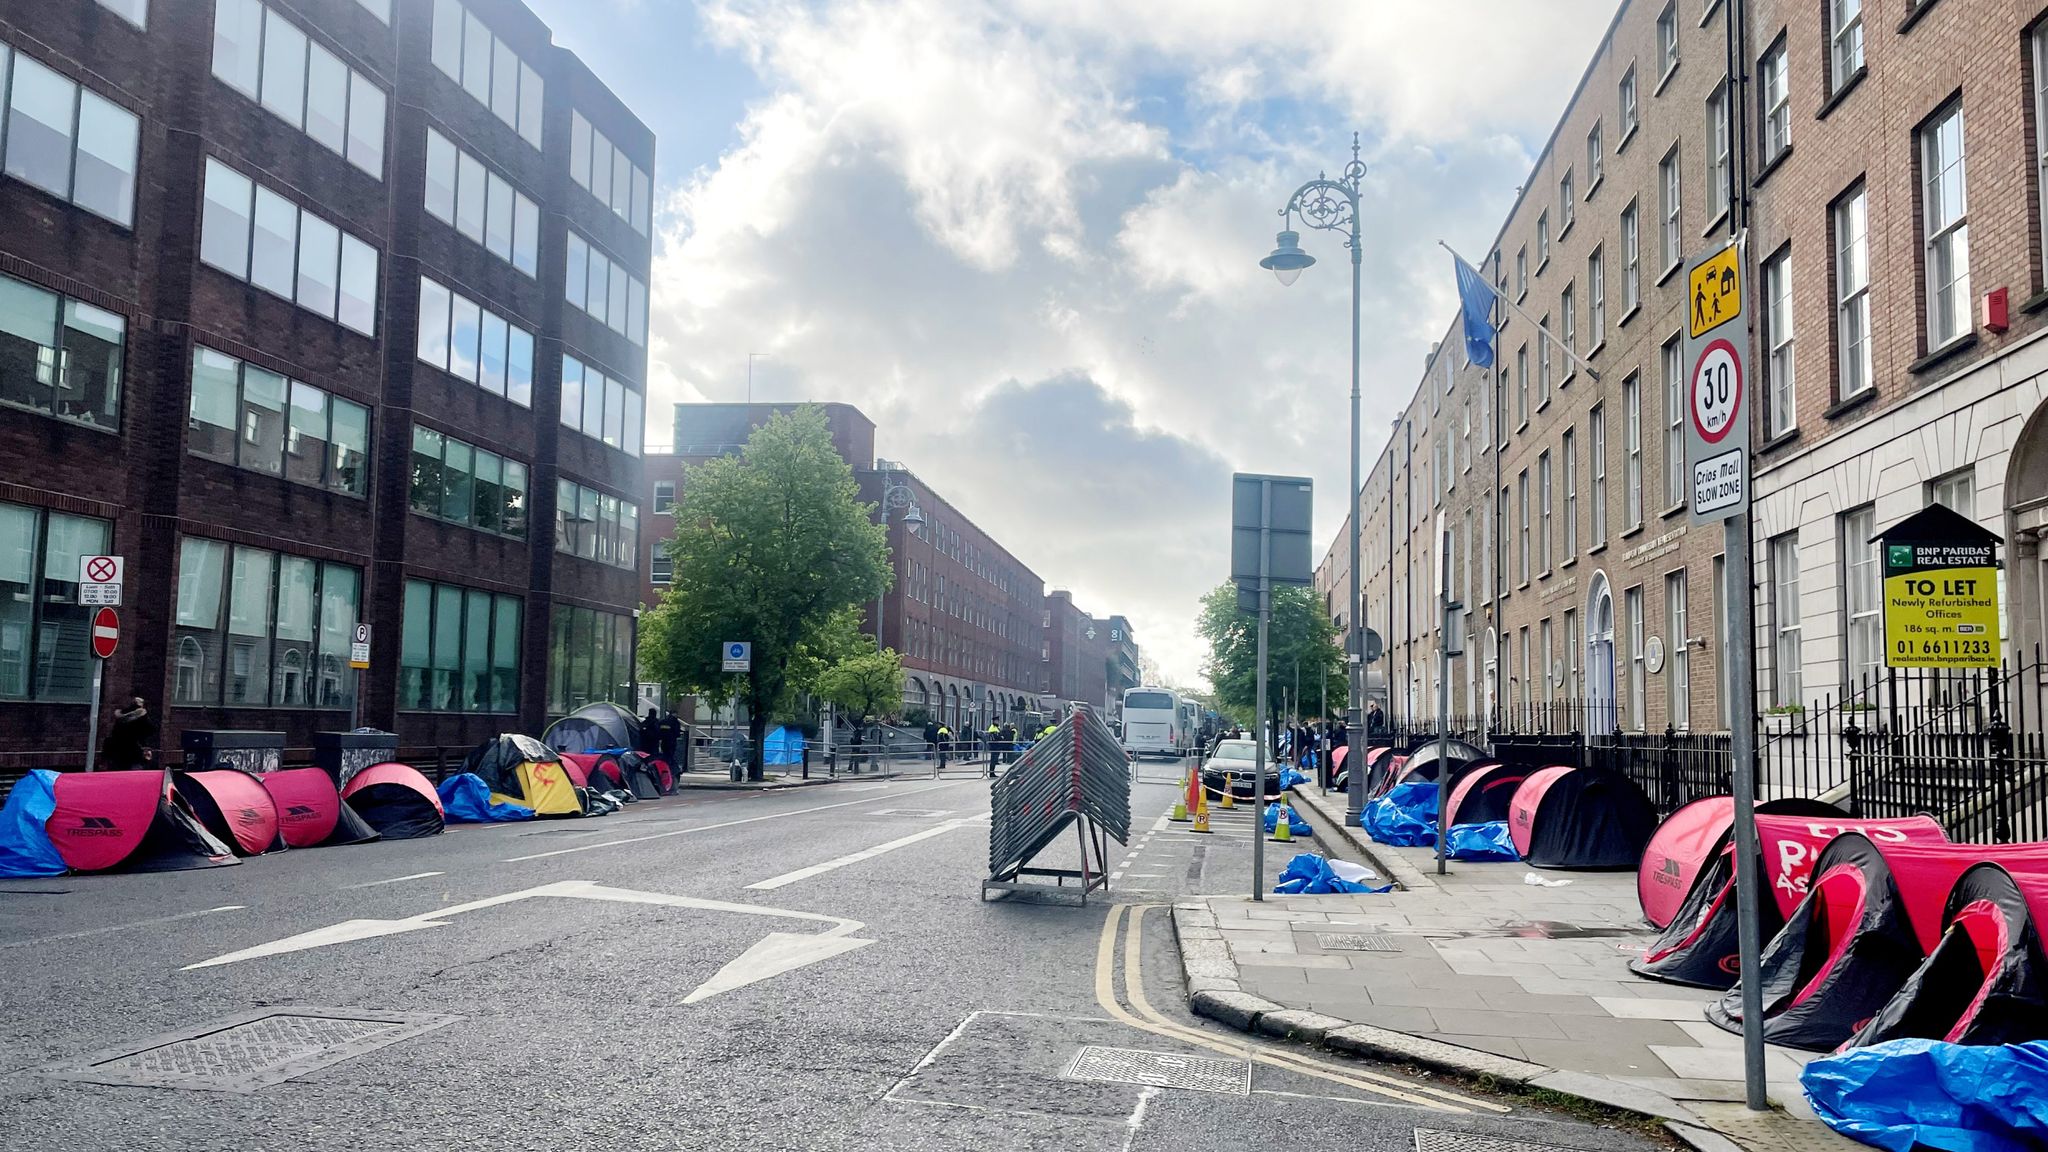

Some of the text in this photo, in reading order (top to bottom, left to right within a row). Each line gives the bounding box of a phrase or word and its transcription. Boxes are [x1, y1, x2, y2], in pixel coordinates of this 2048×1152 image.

[1703, 361, 1728, 410] 30
[1707, 410, 1727, 429] km/h
[1696, 459, 1739, 486] Crios Mall
[1697, 479, 1740, 505] SLOW ZONE
[1917, 547, 1991, 556] BNP PARIBAS
[1917, 556, 1988, 565] REAL ESTATE
[1905, 580, 1977, 596] TO LET
[1892, 598, 1991, 608] Newly Refurbished
[1926, 610, 1962, 619] Offices
[1904, 624, 1922, 633] 186
[1925, 625, 1939, 635] sq.
[1897, 640, 1990, 654] 01 6611233
[1892, 655, 1996, 664] realestate.bnpparibas.ie
[280, 812, 322, 824] TRESPASS
[65, 828, 124, 838] TRESPASS
[1652, 871, 1683, 890] TRESPASS
